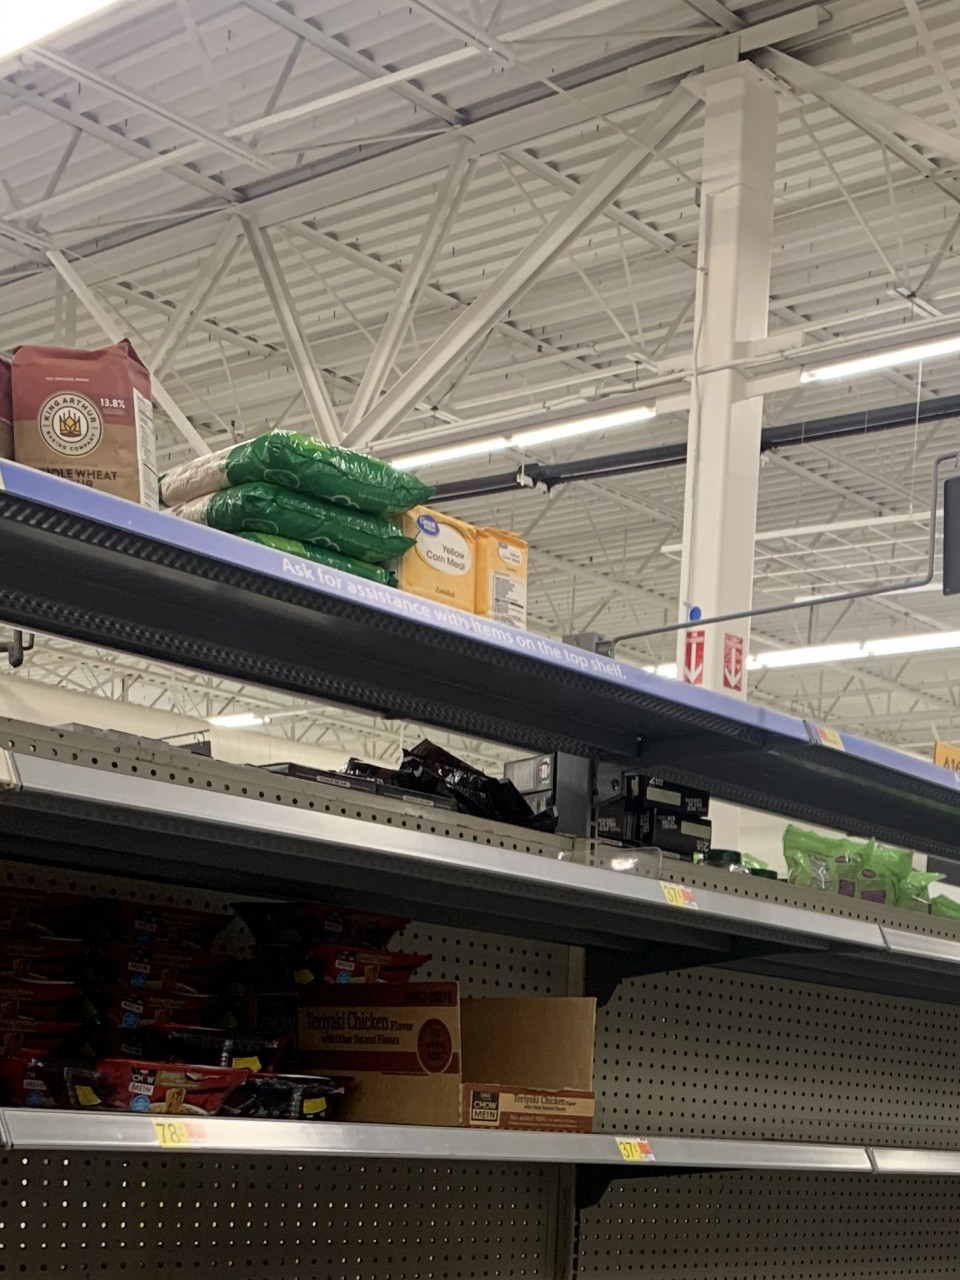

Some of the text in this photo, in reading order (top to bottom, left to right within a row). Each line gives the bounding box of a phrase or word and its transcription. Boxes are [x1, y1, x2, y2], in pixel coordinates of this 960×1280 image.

[44, 397, 97, 423] KING ARTHUR
[100, 398, 126, 409] 13.8%
[46, 431, 96, 451] BAKING COMPANY
[75, 468, 118, 481] WHEAT
[442, 544, 465, 560] Yellow
[426, 549, 466, 572] Corn Meal
[282, 557, 628, 680] Ask for assistance with items on the top shelf.
[305, 1011, 345, 1033] Teriyaki
[347, 1011, 389, 1031] Chicken
[390, 1021, 415, 1032] Flavor
[131, 1083, 152, 1094] MEIN
[473, 1100, 498, 1110] CHOW
[474, 1110, 496, 1120] MEIN
